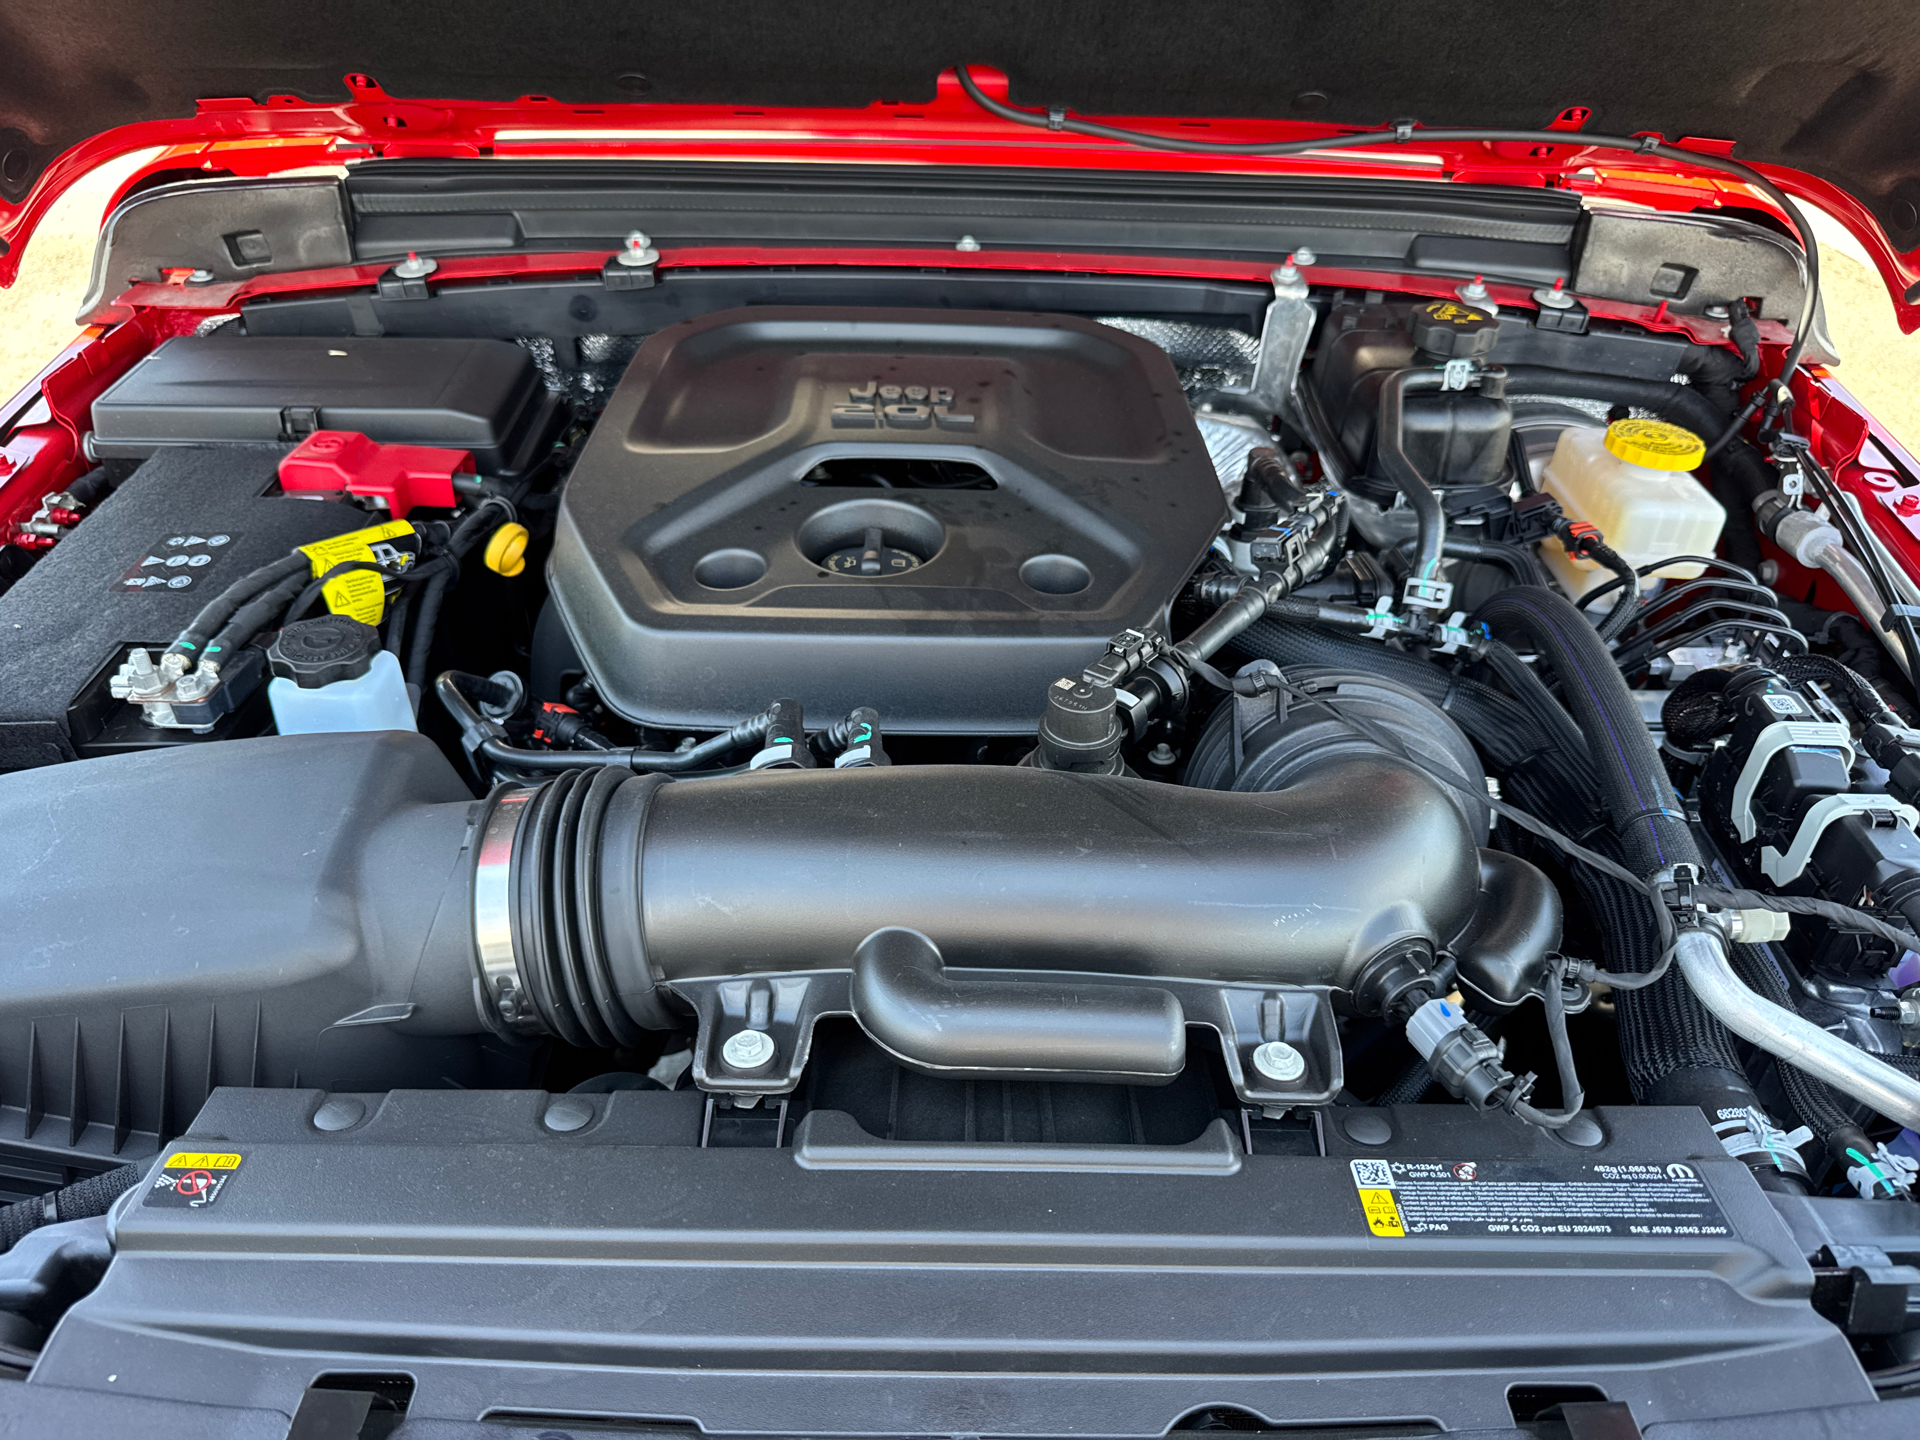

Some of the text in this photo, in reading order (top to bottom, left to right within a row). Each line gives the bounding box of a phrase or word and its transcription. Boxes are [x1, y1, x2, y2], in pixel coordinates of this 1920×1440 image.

[849, 381, 955, 406] Jeep
[830, 403, 976, 430] 2.0L
[1429, 1223, 1448, 1231] PAG
[1488, 1225, 1510, 1233] GWP
[1520, 1225, 1541, 1233] CO2
[1557, 1225, 1571, 1233] EU
